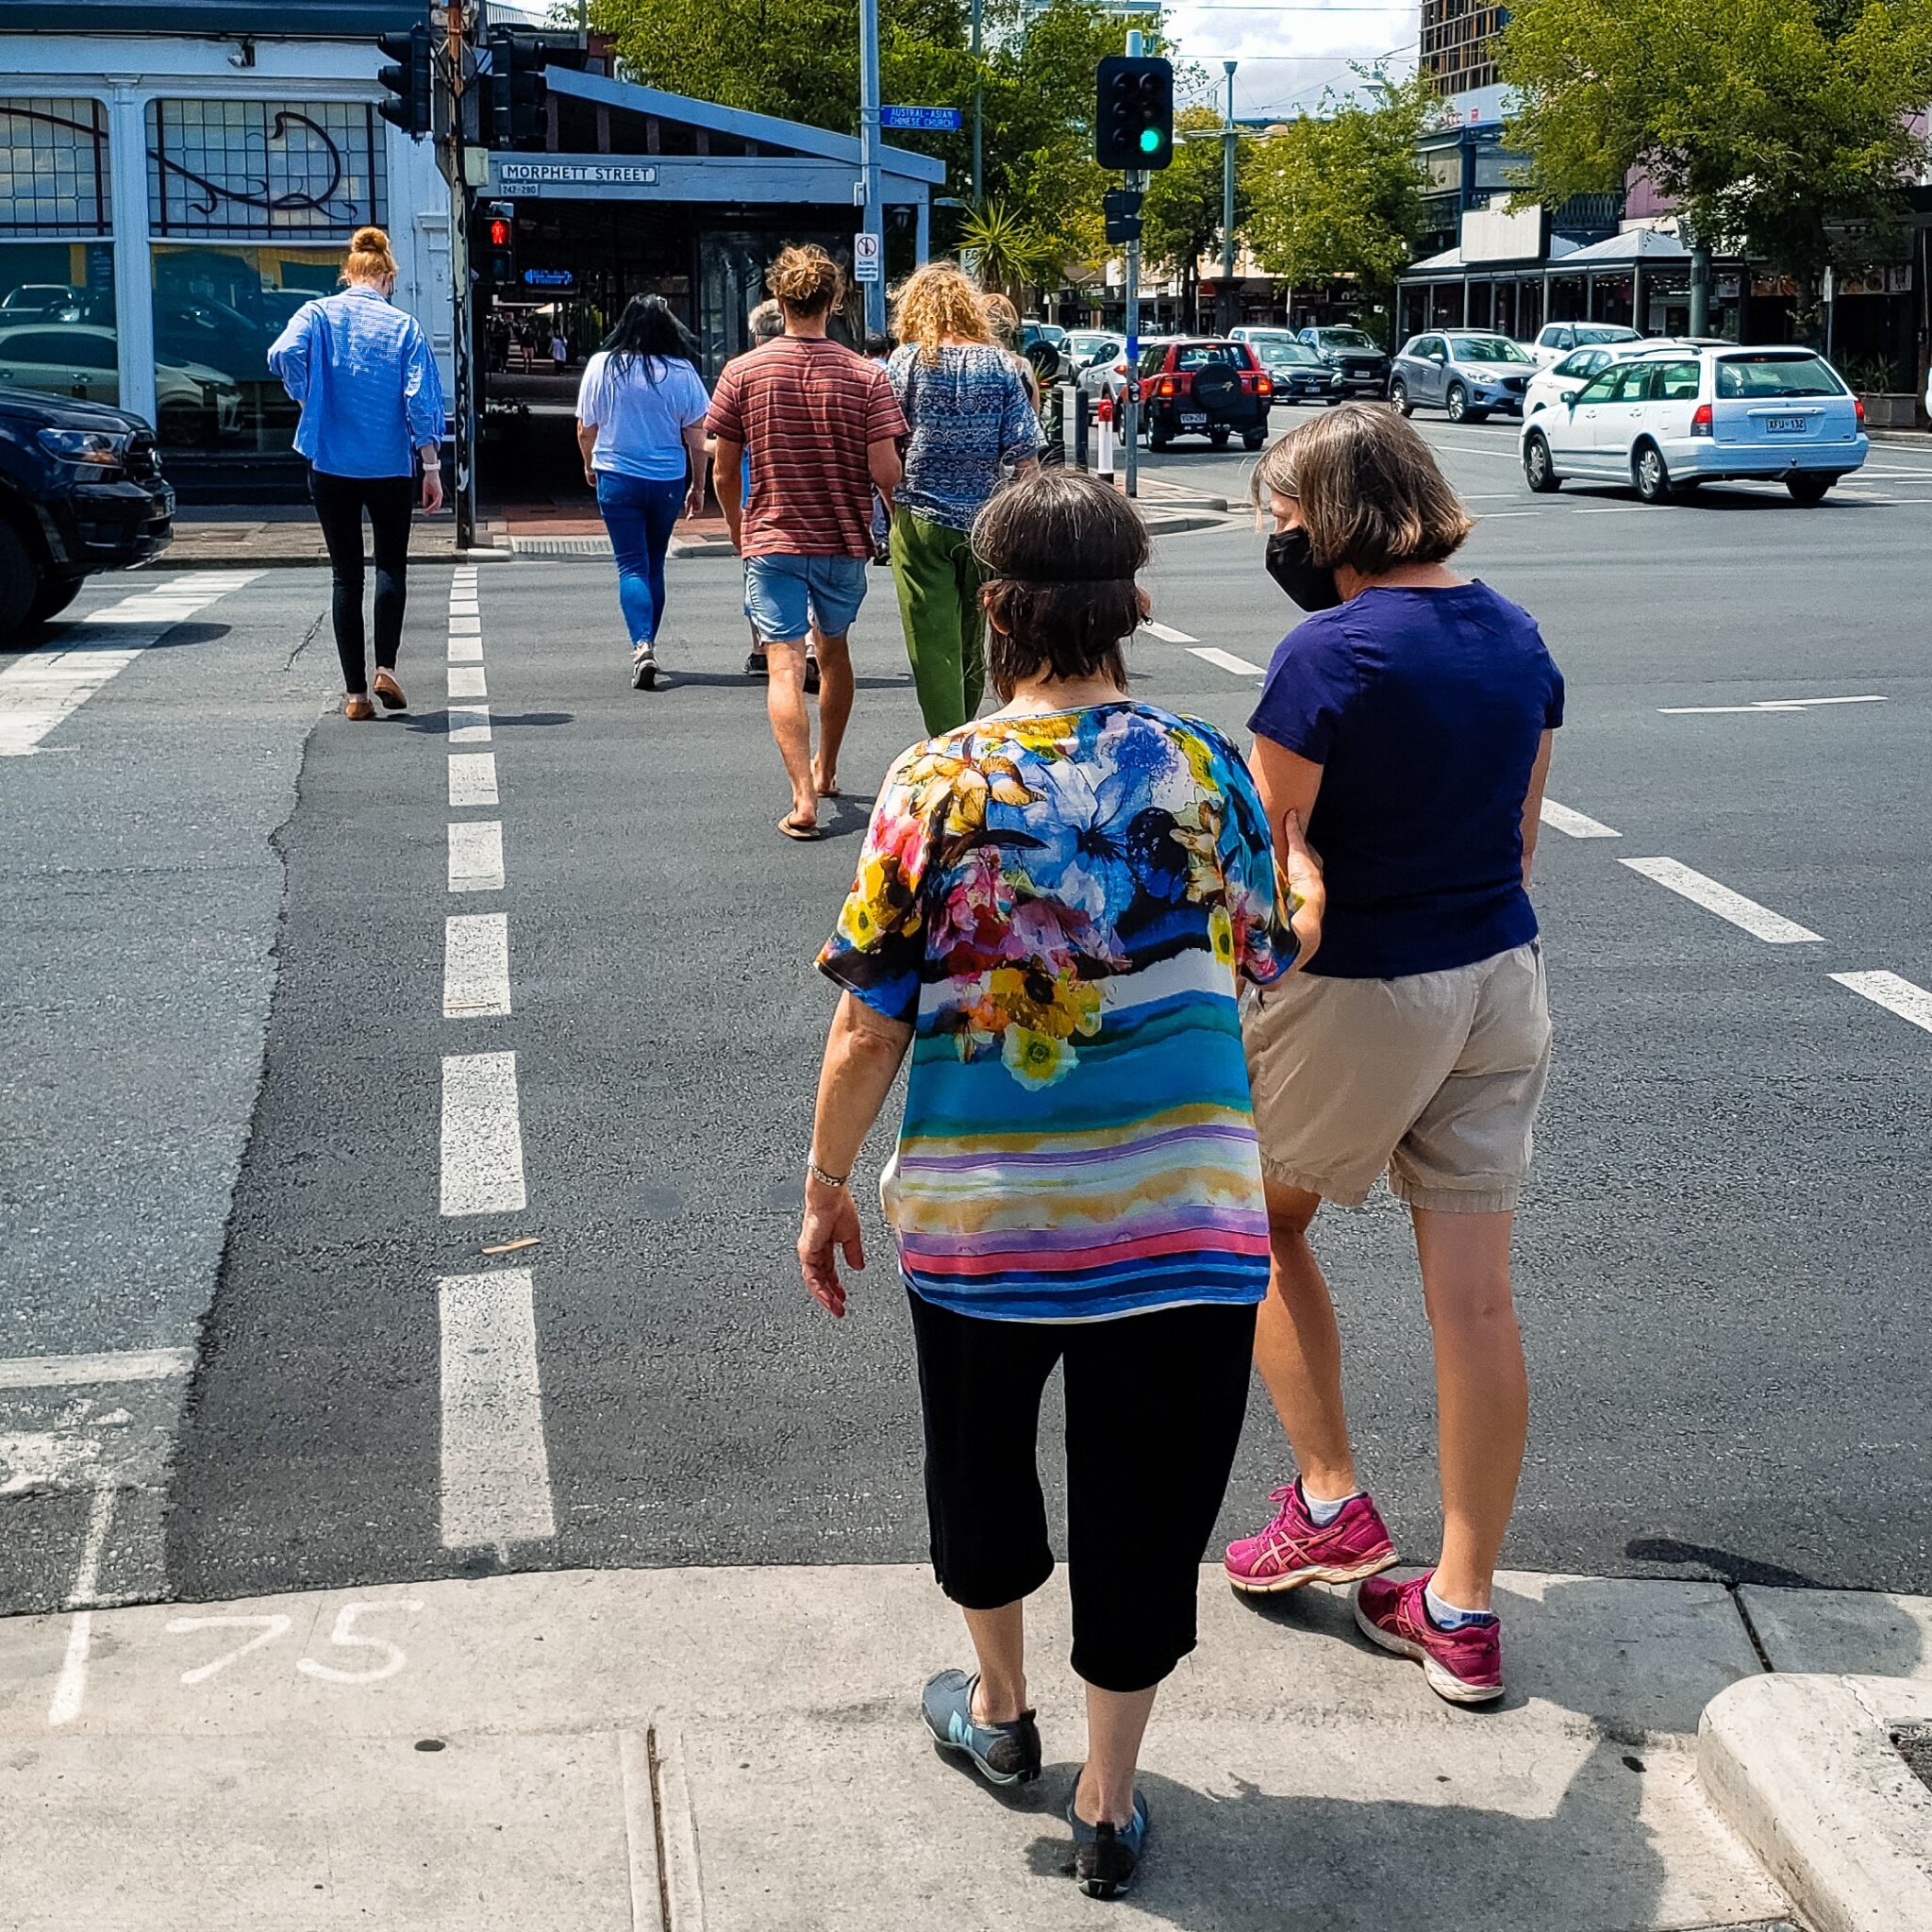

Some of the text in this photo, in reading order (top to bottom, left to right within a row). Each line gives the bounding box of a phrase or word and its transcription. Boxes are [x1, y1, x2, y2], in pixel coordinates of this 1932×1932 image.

[890, 116, 954, 127] CHINESE CHURCH
[508, 166, 650, 181] MORPHETT STREET
